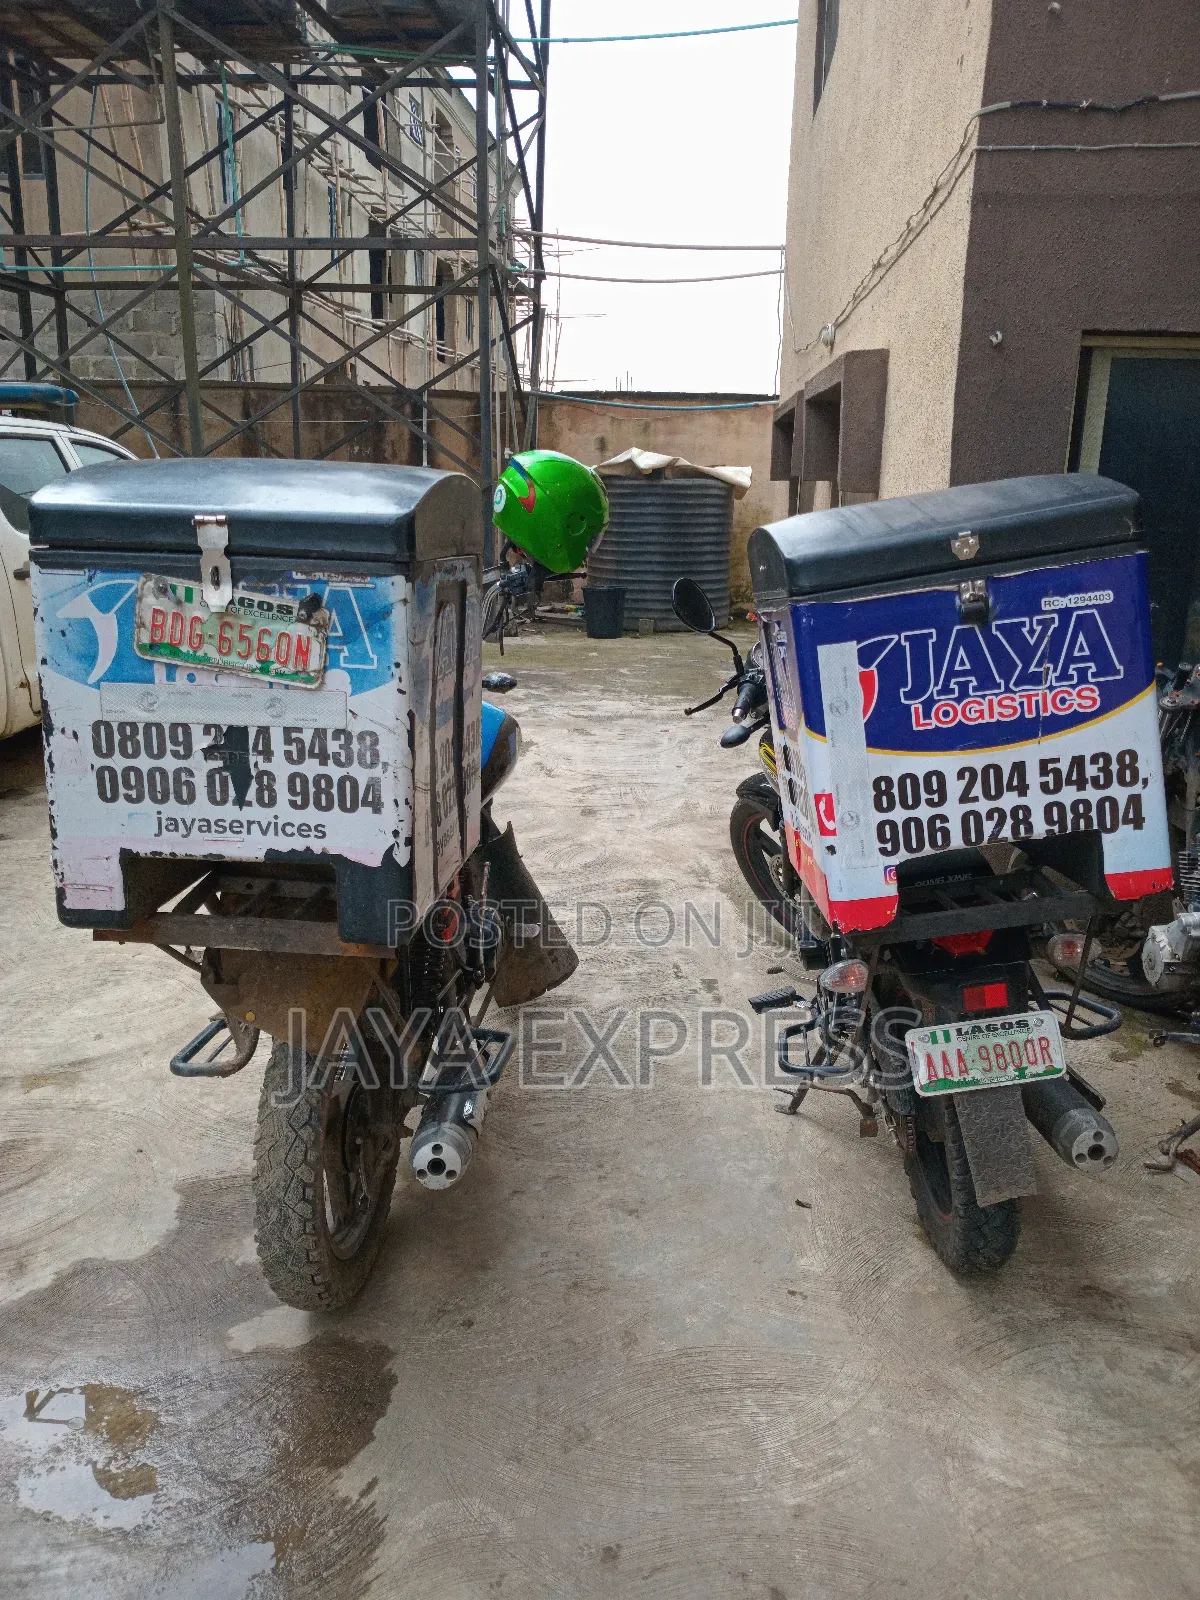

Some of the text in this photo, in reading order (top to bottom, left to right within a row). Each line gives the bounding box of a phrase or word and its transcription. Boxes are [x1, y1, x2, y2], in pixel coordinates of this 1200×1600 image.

[243, 608, 294, 623] EXCELLENCE
[1067, 593, 1111, 605] 1294403
[900, 609, 1124, 704] JAYA
[911, 685, 1100, 730] LOGISTICS
[92, 720, 388, 774] 0809 24 5438,
[96, 766, 197, 805] 0906
[288, 772, 385, 814] 9804
[872, 749, 1149, 814] 809 204 5438,
[154, 811, 327, 840] jayaservices
[876, 814, 952, 857] 906
[961, 804, 1034, 847] 028
[1043, 794, 1146, 837] 9804
[955, 1020, 1030, 1036] LAGOS
